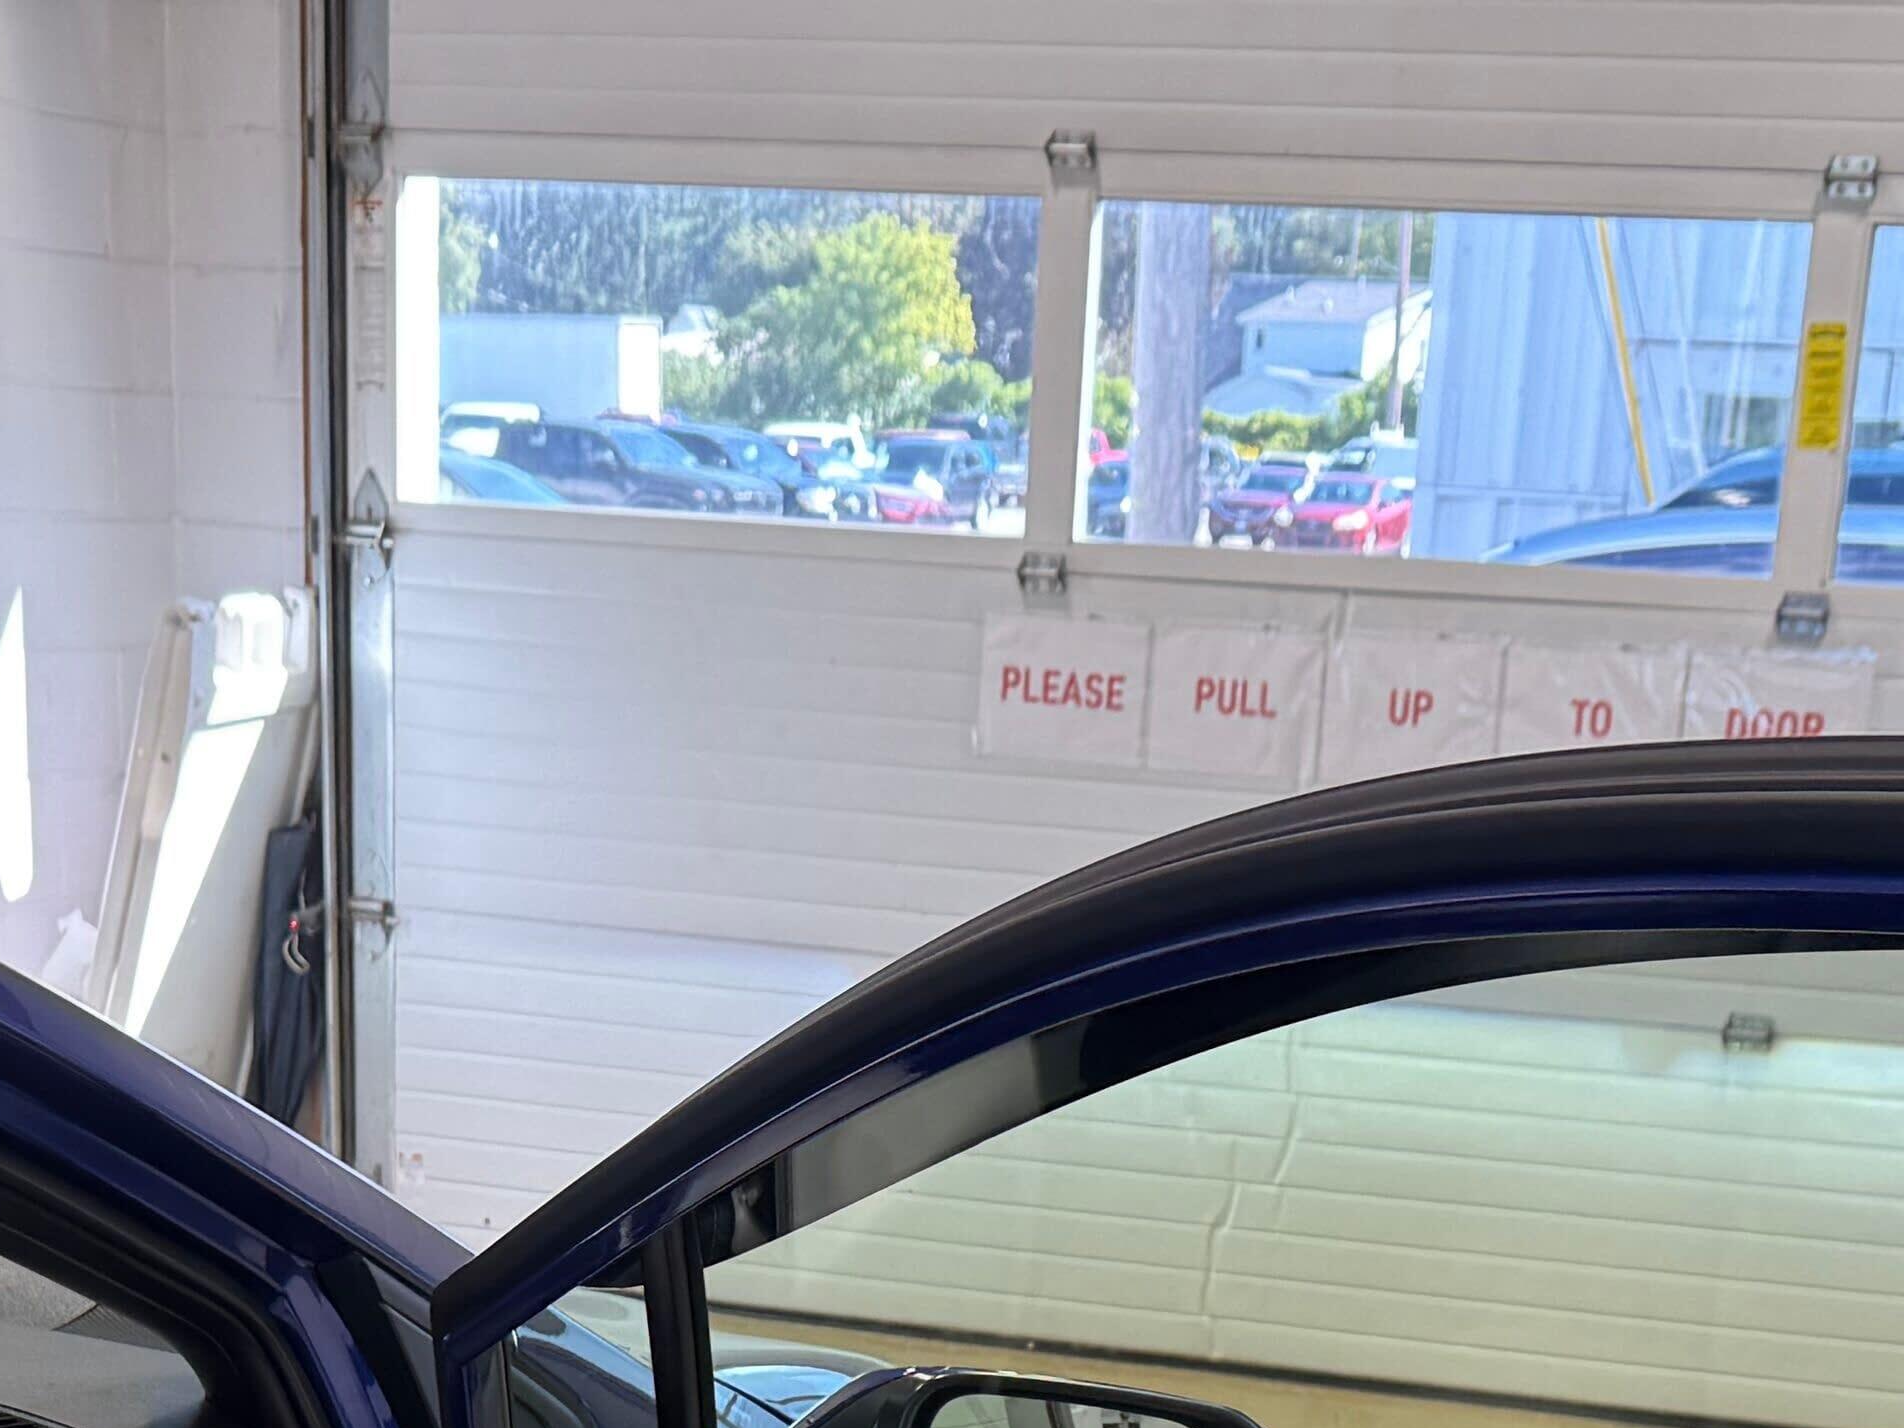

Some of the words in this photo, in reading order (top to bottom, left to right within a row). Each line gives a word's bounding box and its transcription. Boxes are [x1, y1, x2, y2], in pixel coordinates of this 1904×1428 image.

[1000, 665, 1127, 712] PLEASE
[1193, 676, 1277, 718] PULL
[1388, 688, 1434, 728] UP
[1570, 699, 1613, 738] TO
[1723, 707, 1825, 739] DOOR
